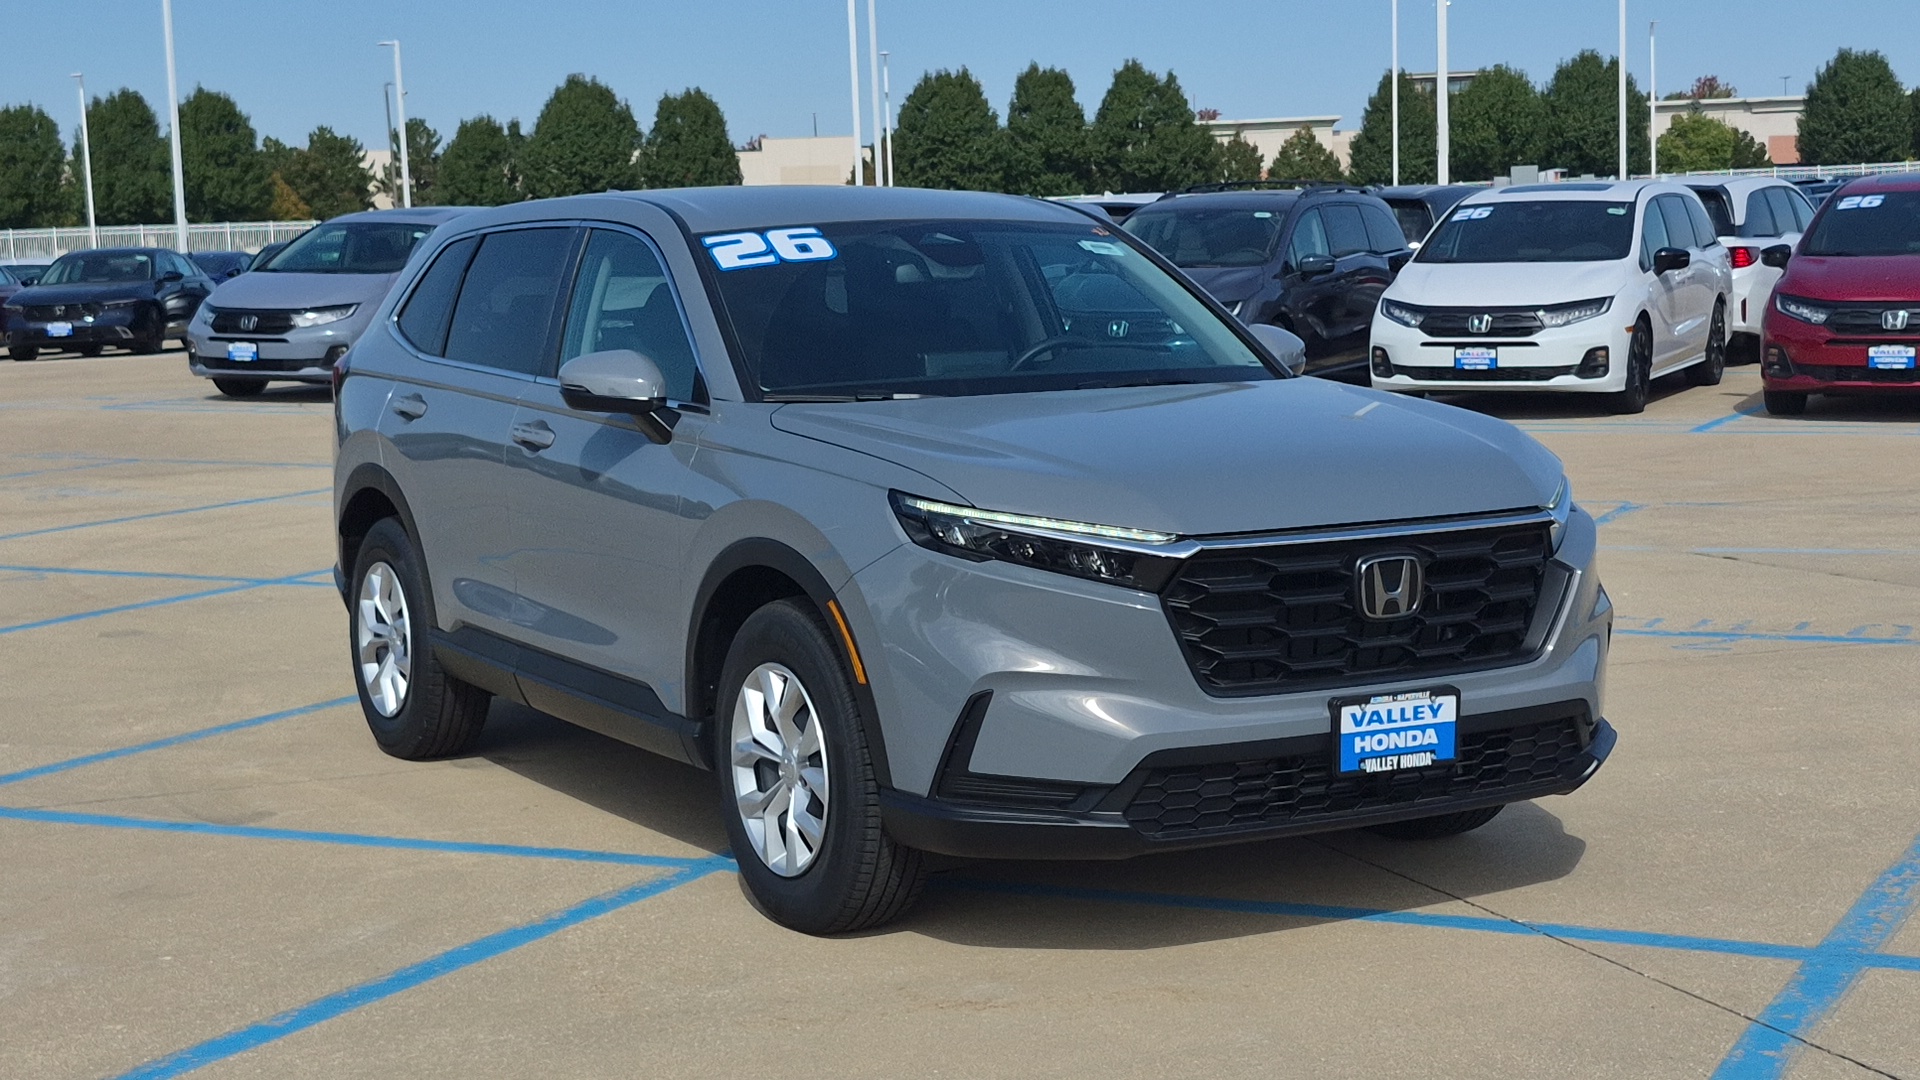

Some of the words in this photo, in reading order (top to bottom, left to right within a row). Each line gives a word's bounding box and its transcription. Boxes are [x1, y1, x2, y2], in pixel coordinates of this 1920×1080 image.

[1451, 206, 1494, 221] 26
[1837, 195, 1885, 210] 26
[702, 227, 837, 271] 26
[1350, 703, 1443, 728] VALLEY
[1354, 728, 1439, 754] HONDA
[1365, 756, 1399, 773] VALLEY
[1400, 752, 1432, 769] HONDA
